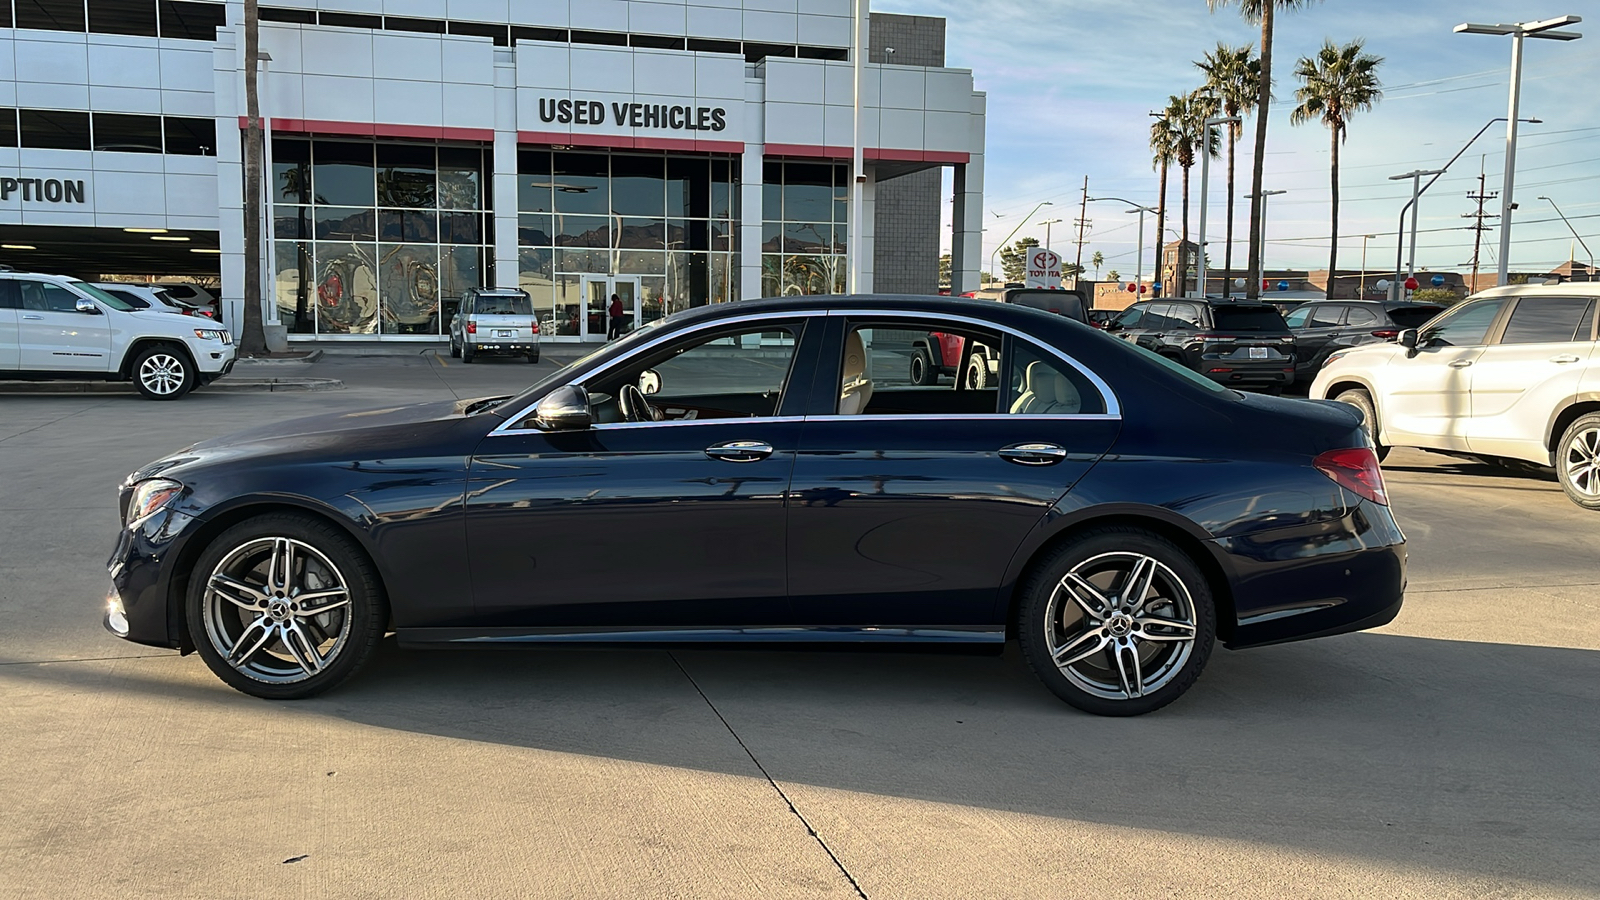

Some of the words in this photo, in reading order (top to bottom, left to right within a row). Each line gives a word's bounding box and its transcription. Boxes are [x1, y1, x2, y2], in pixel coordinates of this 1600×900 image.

[539, 98, 605, 125] USED
[612, 102, 726, 131] VEHICLES
[0, 177, 84, 203] PTION
